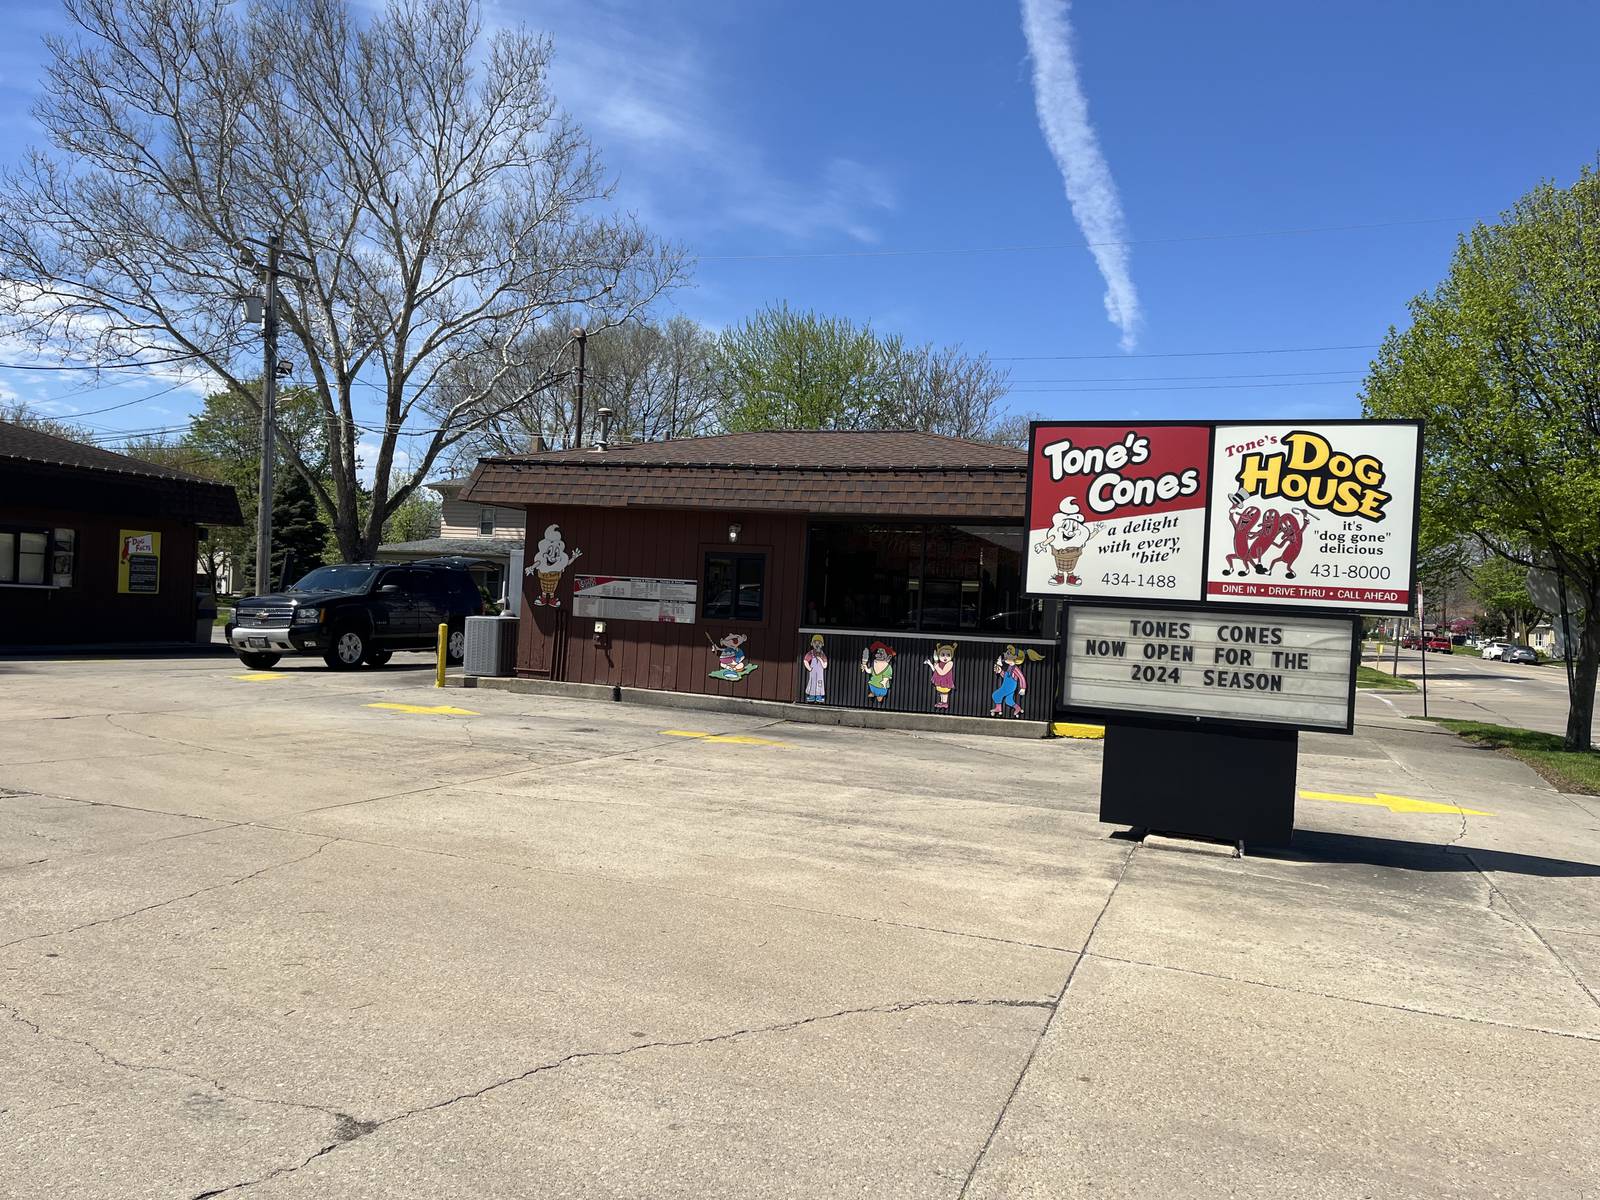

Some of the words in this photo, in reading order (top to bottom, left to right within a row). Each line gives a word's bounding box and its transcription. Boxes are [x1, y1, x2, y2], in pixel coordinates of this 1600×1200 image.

[1224, 434, 1278, 458] Tone's
[1043, 432, 1150, 481] Tone's
[1087, 469, 1199, 514] Cones
[1107, 525, 1117, 537] a
[1122, 516, 1179, 535] delight
[1342, 521, 1363, 532] it's
[1098, 539, 1131, 555] with
[1137, 536, 1180, 551] every
[1314, 530, 1346, 544] "dog
[1350, 531, 1392, 545] gone"
[1131, 546, 1181, 564] "bite"
[1319, 543, 1384, 556] delicious
[1101, 572, 1177, 589] 434-1488
[1310, 563, 1391, 580] 431-8000
[1222, 584, 1244, 594] DINE
[1246, 585, 1257, 594] IN
[1268, 586, 1296, 597] DRIVE
[1299, 588, 1326, 598] THRU
[1337, 590, 1363, 600] CALL
[1364, 591, 1398, 601] AHEAD
[1130, 620, 1191, 640] TONES
[1217, 625, 1282, 645] CONES
[1086, 639, 1126, 658] NOW
[1143, 643, 1194, 662] OPEN
[1214, 647, 1252, 666] FOR
[1272, 651, 1309, 670] THE
[1131, 664, 1180, 684] 2024
[1203, 669, 1282, 692] SEASON
